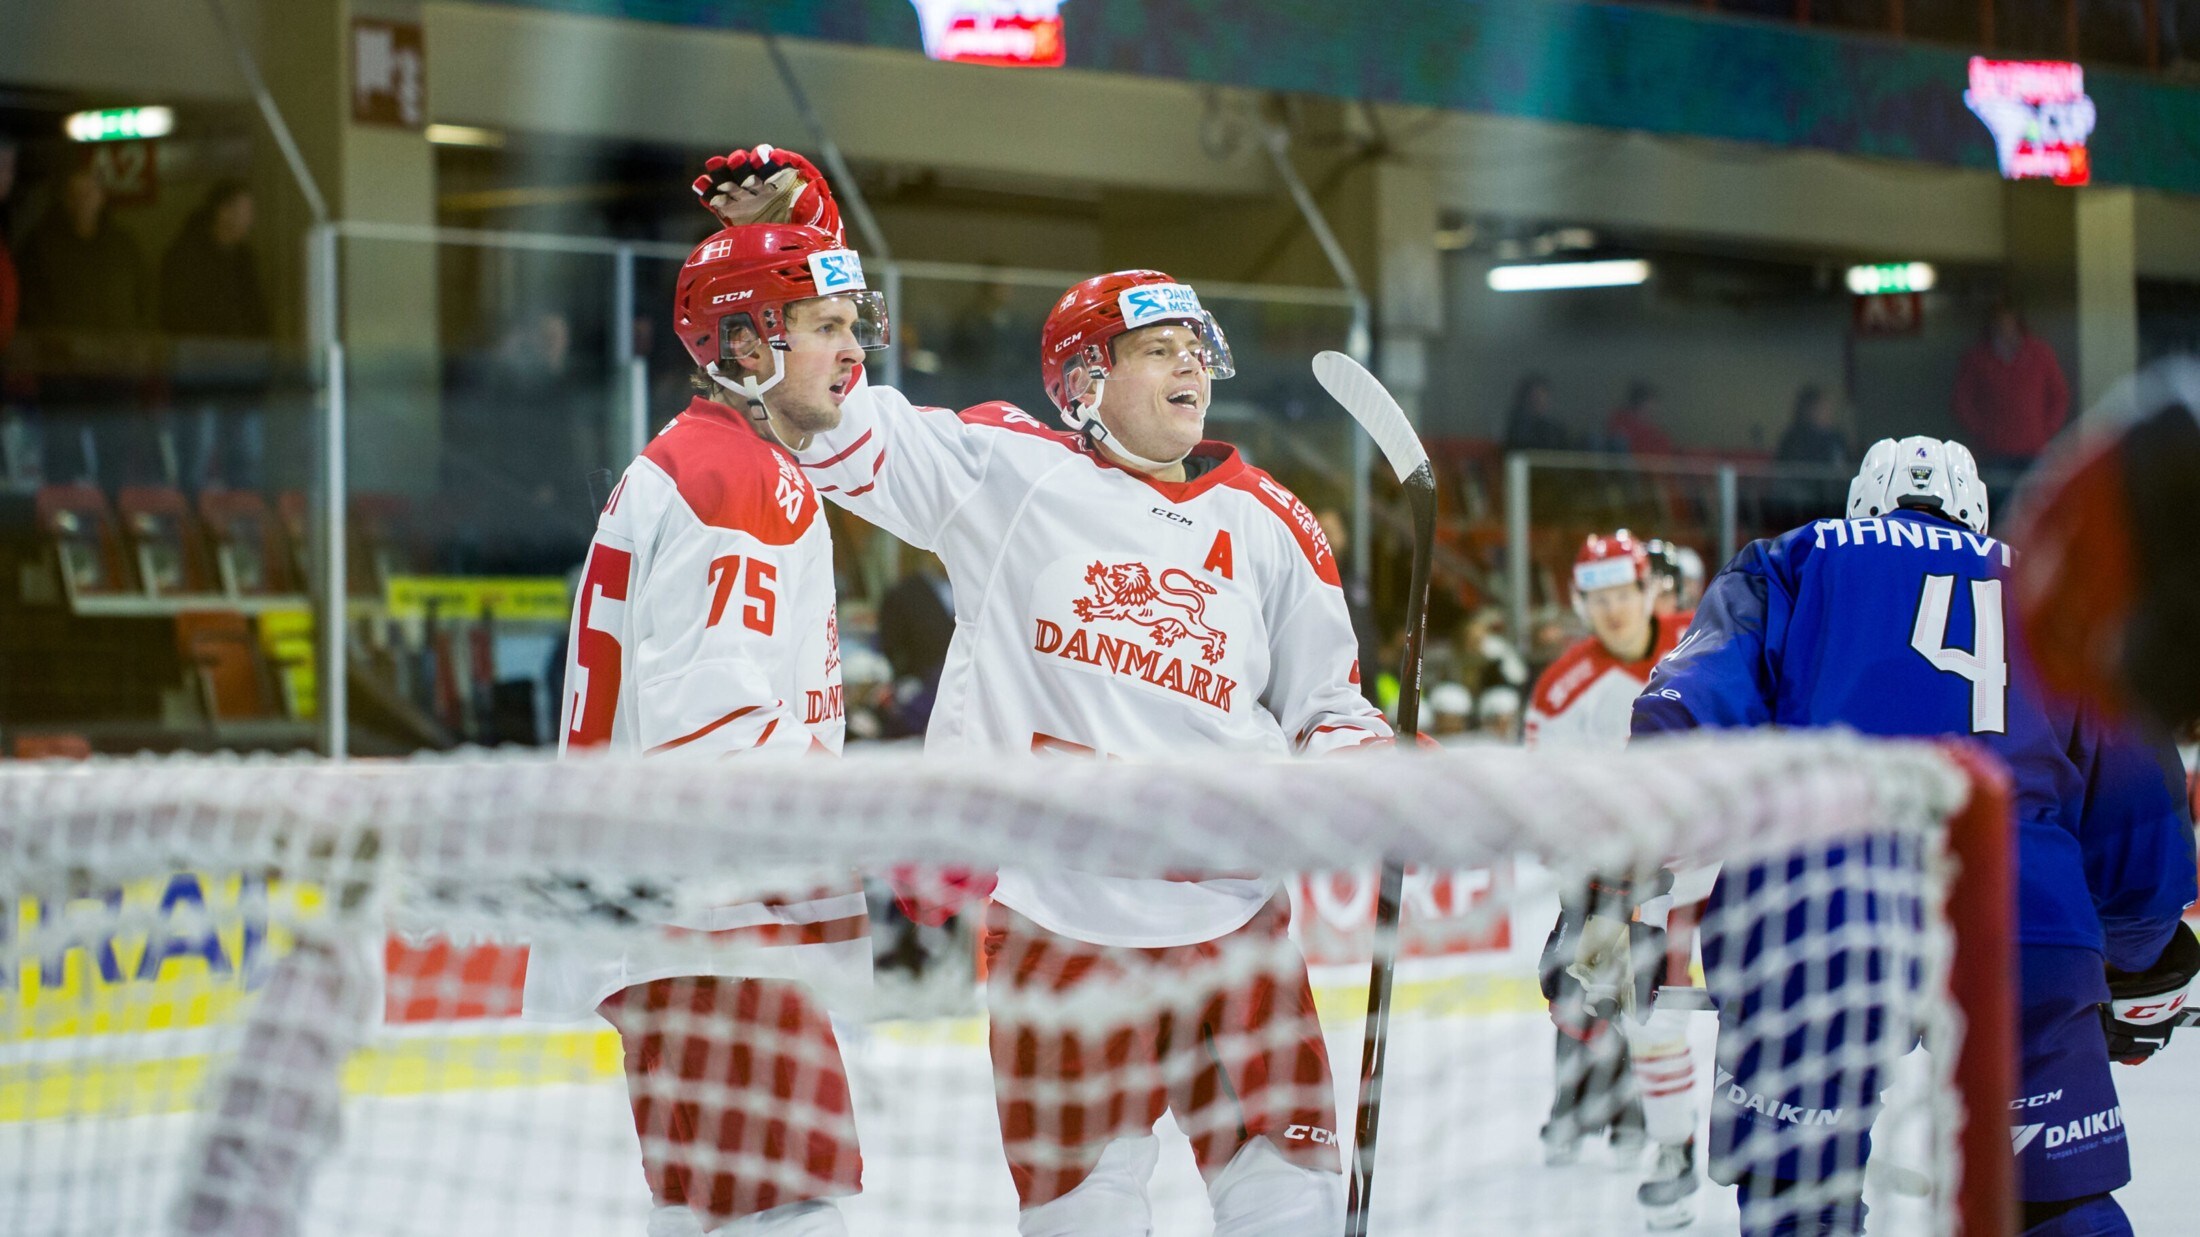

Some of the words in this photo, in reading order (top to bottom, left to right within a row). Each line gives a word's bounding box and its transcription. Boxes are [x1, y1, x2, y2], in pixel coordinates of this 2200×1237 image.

[712, 289, 754, 305] CCM
[1055, 331, 1083, 353] CCM
[1151, 507, 1193, 526] CCM
[1203, 529, 1233, 580] A
[1813, 517, 2013, 568] MANAVI
[705, 554, 777, 637] 75
[1034, 618, 1238, 714] DANMARK
[1908, 571, 2008, 736] 4
[1726, 1083, 1843, 1126] DAIKIN
[2008, 1088, 2063, 1111] CCM
[1283, 1124, 1337, 1148] CCM
